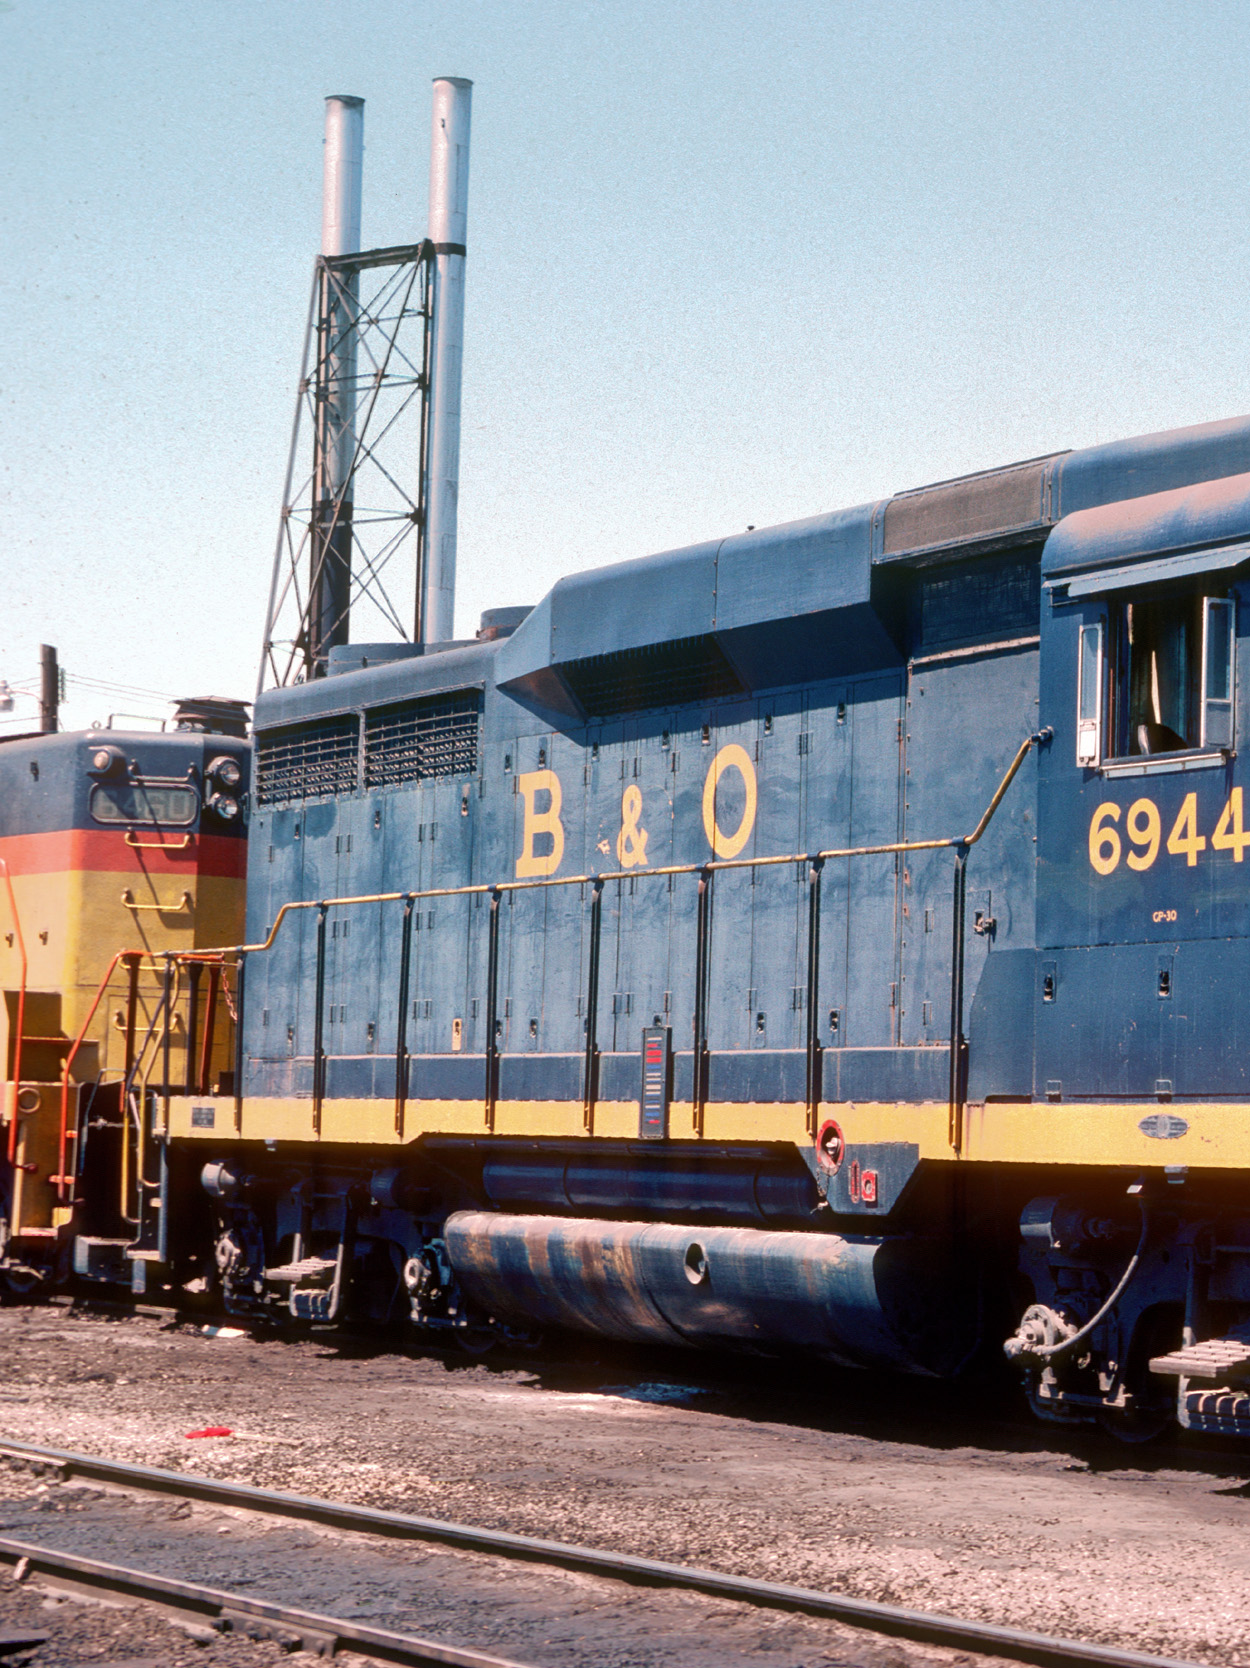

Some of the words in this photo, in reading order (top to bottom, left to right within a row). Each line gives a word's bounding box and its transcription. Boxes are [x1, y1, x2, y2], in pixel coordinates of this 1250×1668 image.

[515, 769, 565, 878] B
[616, 784, 649, 868] &
[702, 743, 758, 860] O
[1152, 910, 1177, 922] GP-30
